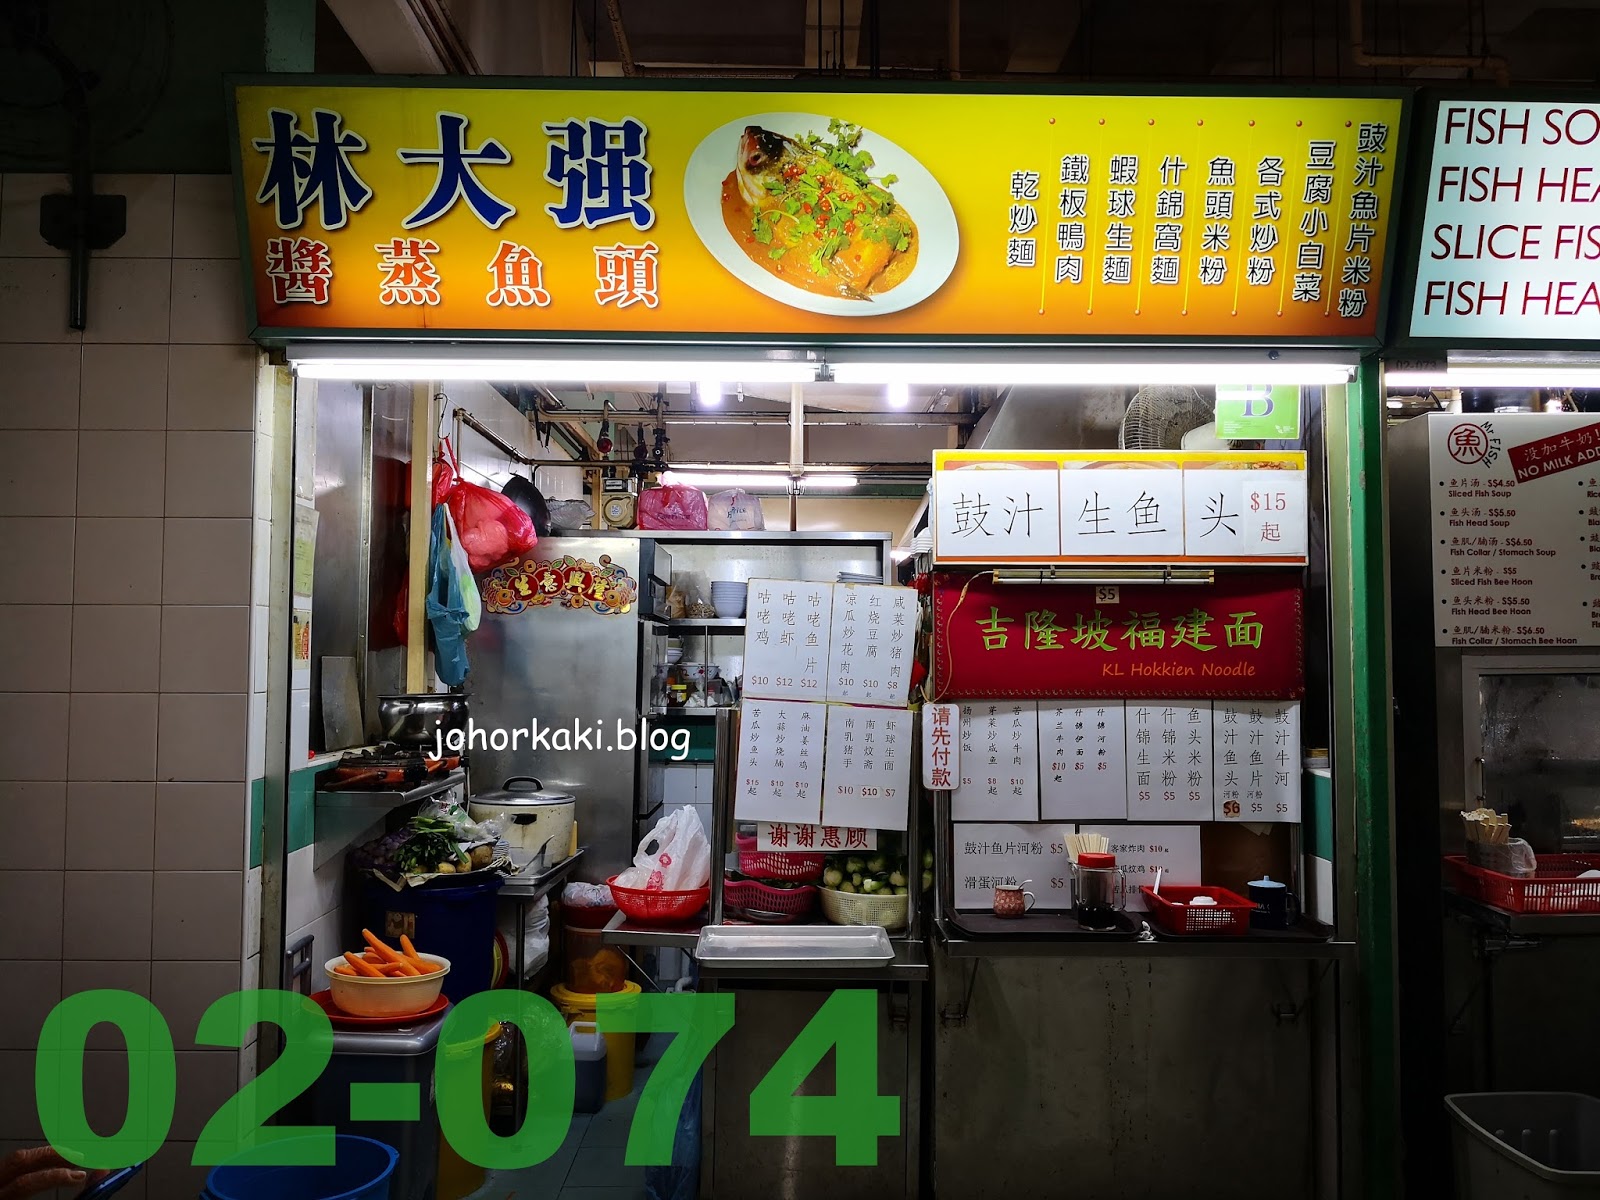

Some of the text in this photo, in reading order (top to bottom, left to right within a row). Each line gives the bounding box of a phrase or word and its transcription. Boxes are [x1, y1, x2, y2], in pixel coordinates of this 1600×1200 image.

[1445, 108, 1530, 144] FISH
[253, 108, 654, 230] 林大强
[1438, 167, 1523, 202] FISH
[1007, 171, 1039, 267] 乾炒麵
[1055, 155, 1089, 283] 鐵板鴨肉
[1103, 156, 1139, 284] 蝦球生麵
[1151, 156, 1187, 284] 什錦窩麵
[1199, 157, 1235, 284] 魚頭米粉
[1248, 157, 1285, 285] 各式炒粉
[1292, 140, 1336, 302] 豆腐小白菜
[1431, 224, 1542, 260] SLICE
[267, 237, 659, 308] 醬蒸魚頭
[1424, 281, 1508, 316] FISH
[1453, 428, 1483, 457] 魚
[1481, 421, 1501, 469] Mr FISH
[1518, 465, 1539, 480] NO
[1543, 455, 1573, 472] MILK
[1450, 479, 1479, 488] 鱼片汤
[1251, 491, 1286, 512] $15
[1448, 490, 1511, 499] Sliced Fish Soup
[1450, 508, 1480, 517] 鱼头汤
[1260, 522, 1280, 542] 起
[1490, 520, 1510, 528] Soup
[1536, 549, 1556, 557] Soup
[1452, 567, 1493, 576] 鱼片米粉
[1098, 586, 1116, 601] $5
[1452, 596, 1494, 605] 鱼头米粉
[755, 589, 771, 645] 咕咾鸡
[780, 591, 796, 646] 咕咾虾
[866, 595, 881, 658] 红烧豆腐
[890, 596, 905, 678] 咸菜炒猪肉
[975, 606, 1264, 652] 吉隆坡福建面
[1102, 662, 1256, 677] KL Hokkien Noodle
[752, 676, 769, 685] $10
[776, 677, 793, 687] $12
[801, 678, 818, 689] $12
[839, 678, 854, 686] $10
[863, 680, 878, 688] $10
[888, 681, 898, 690] $8
[885, 721, 896, 770] 虾球生面
[1012, 706, 1022, 765] 苦瓜炒牛肉
[932, 707, 951, 787] 请先付款
[1136, 708, 1150, 786] 什锦生面
[1161, 708, 1177, 787] 什锦米粉
[1187, 708, 1203, 787] 鱼头米粉
[1052, 762, 1066, 771] $10
[1098, 762, 1107, 770] $5
[838, 786, 853, 795] $10
[862, 787, 877, 796] $10
[885, 789, 895, 797] $7
[1139, 791, 1150, 801] $5
[1164, 791, 1175, 801] $5
[1189, 791, 1200, 801] $5
[1223, 801, 1240, 816] $6
[1251, 803, 1263, 813] $5
[1276, 803, 1288, 813] $5
[768, 824, 867, 848] 谢谢惠顾
[1050, 843, 1063, 854] $5
[1149, 845, 1163, 853] $10
[1051, 878, 1064, 888] $5
